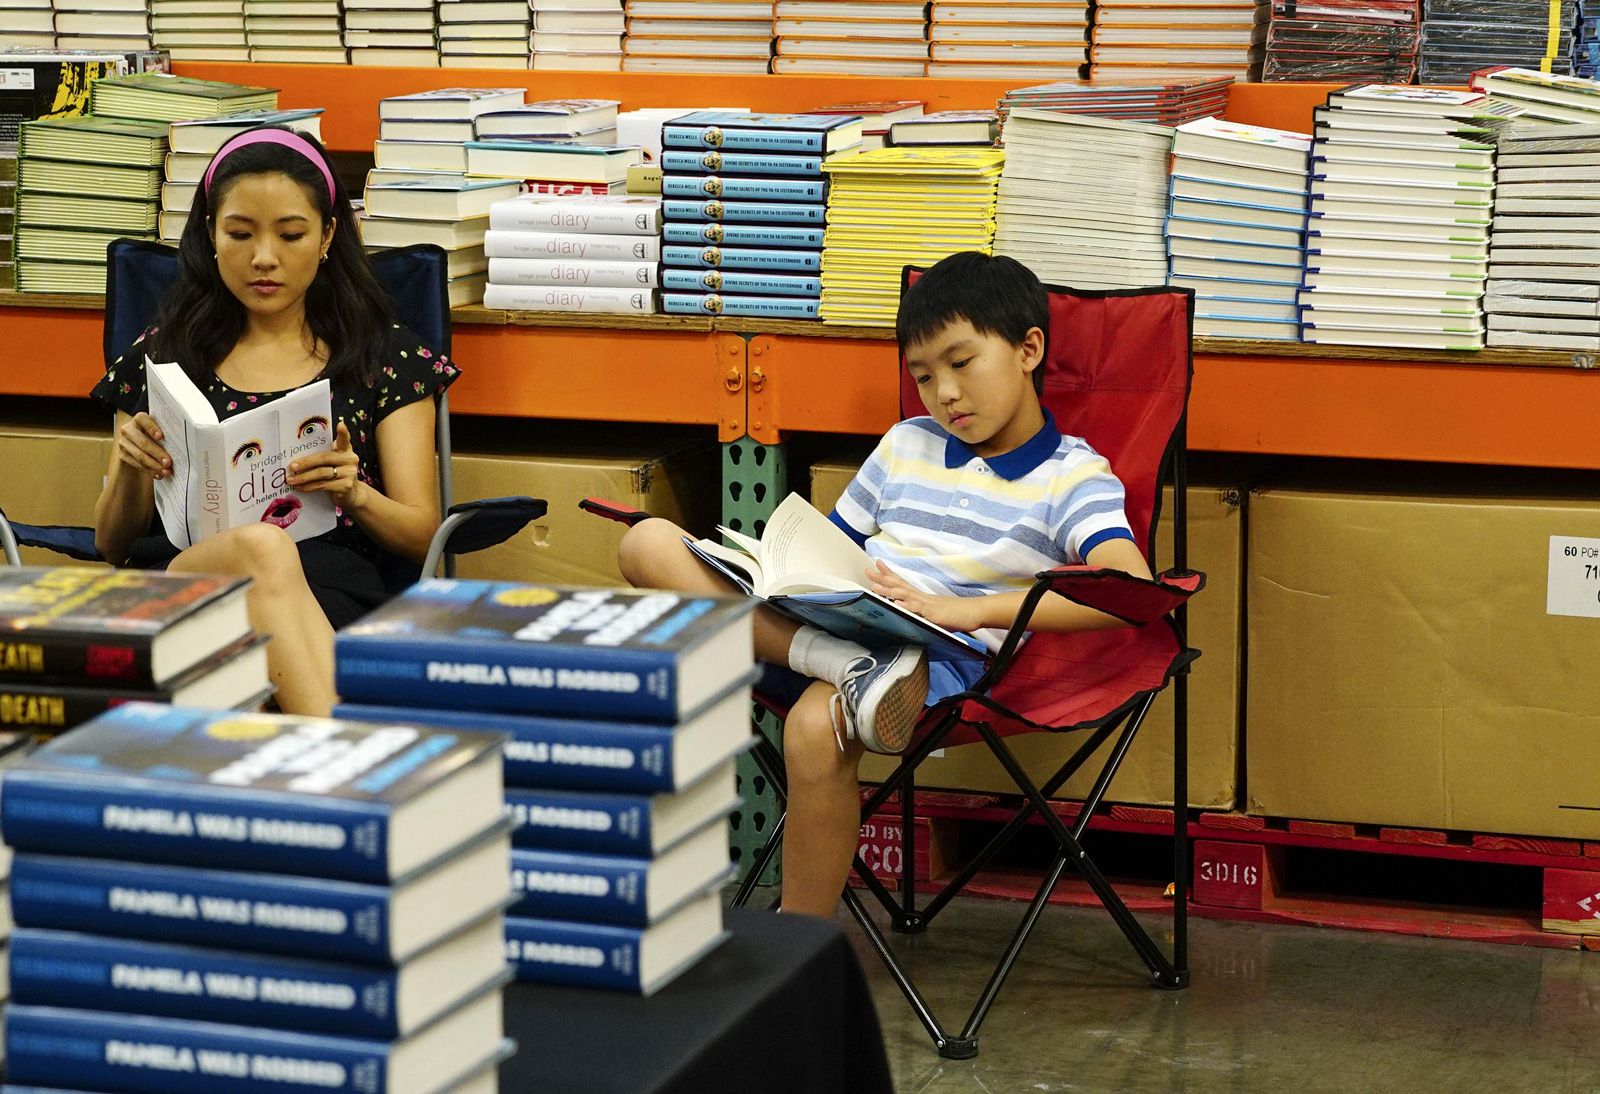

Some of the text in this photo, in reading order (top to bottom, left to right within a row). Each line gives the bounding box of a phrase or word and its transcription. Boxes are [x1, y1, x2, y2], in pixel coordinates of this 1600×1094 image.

[550, 211, 590, 230] diary
[546, 238, 587, 257] diary
[551, 264, 590, 283] diary
[545, 290, 585, 309] diary
[250, 436, 326, 471] bridget jones's
[203, 479, 222, 514] diary
[239, 467, 288, 503] dia
[256, 492, 278, 504] helen
[1564, 546, 1599, 558] 60 PO#
[1585, 564, 1600, 580] 71
[426, 661, 507, 686] PAMELA
[507, 665, 555, 688] WAS
[556, 668, 640, 693] ROBBED
[0, 693, 65, 726] DEATH
[551, 743, 635, 769] ROBBED
[103, 804, 194, 837] PAMELA
[195, 812, 249, 842] WAS
[250, 817, 346, 850] ROBBED
[529, 805, 612, 832] ROBBED
[526, 870, 610, 897] ROBBED
[108, 886, 198, 920] PAMELA
[199, 895, 251, 925] WAS
[252, 902, 347, 934] ROBBED
[522, 941, 605, 968] ROBBED
[111, 963, 203, 996] PAMELA
[204, 972, 257, 1001] WAS
[259, 977, 357, 1010] ROBBED
[105, 1040, 196, 1073] PAMELA
[196, 1049, 250, 1078] WAS
[251, 1054, 346, 1088] ROBBED
